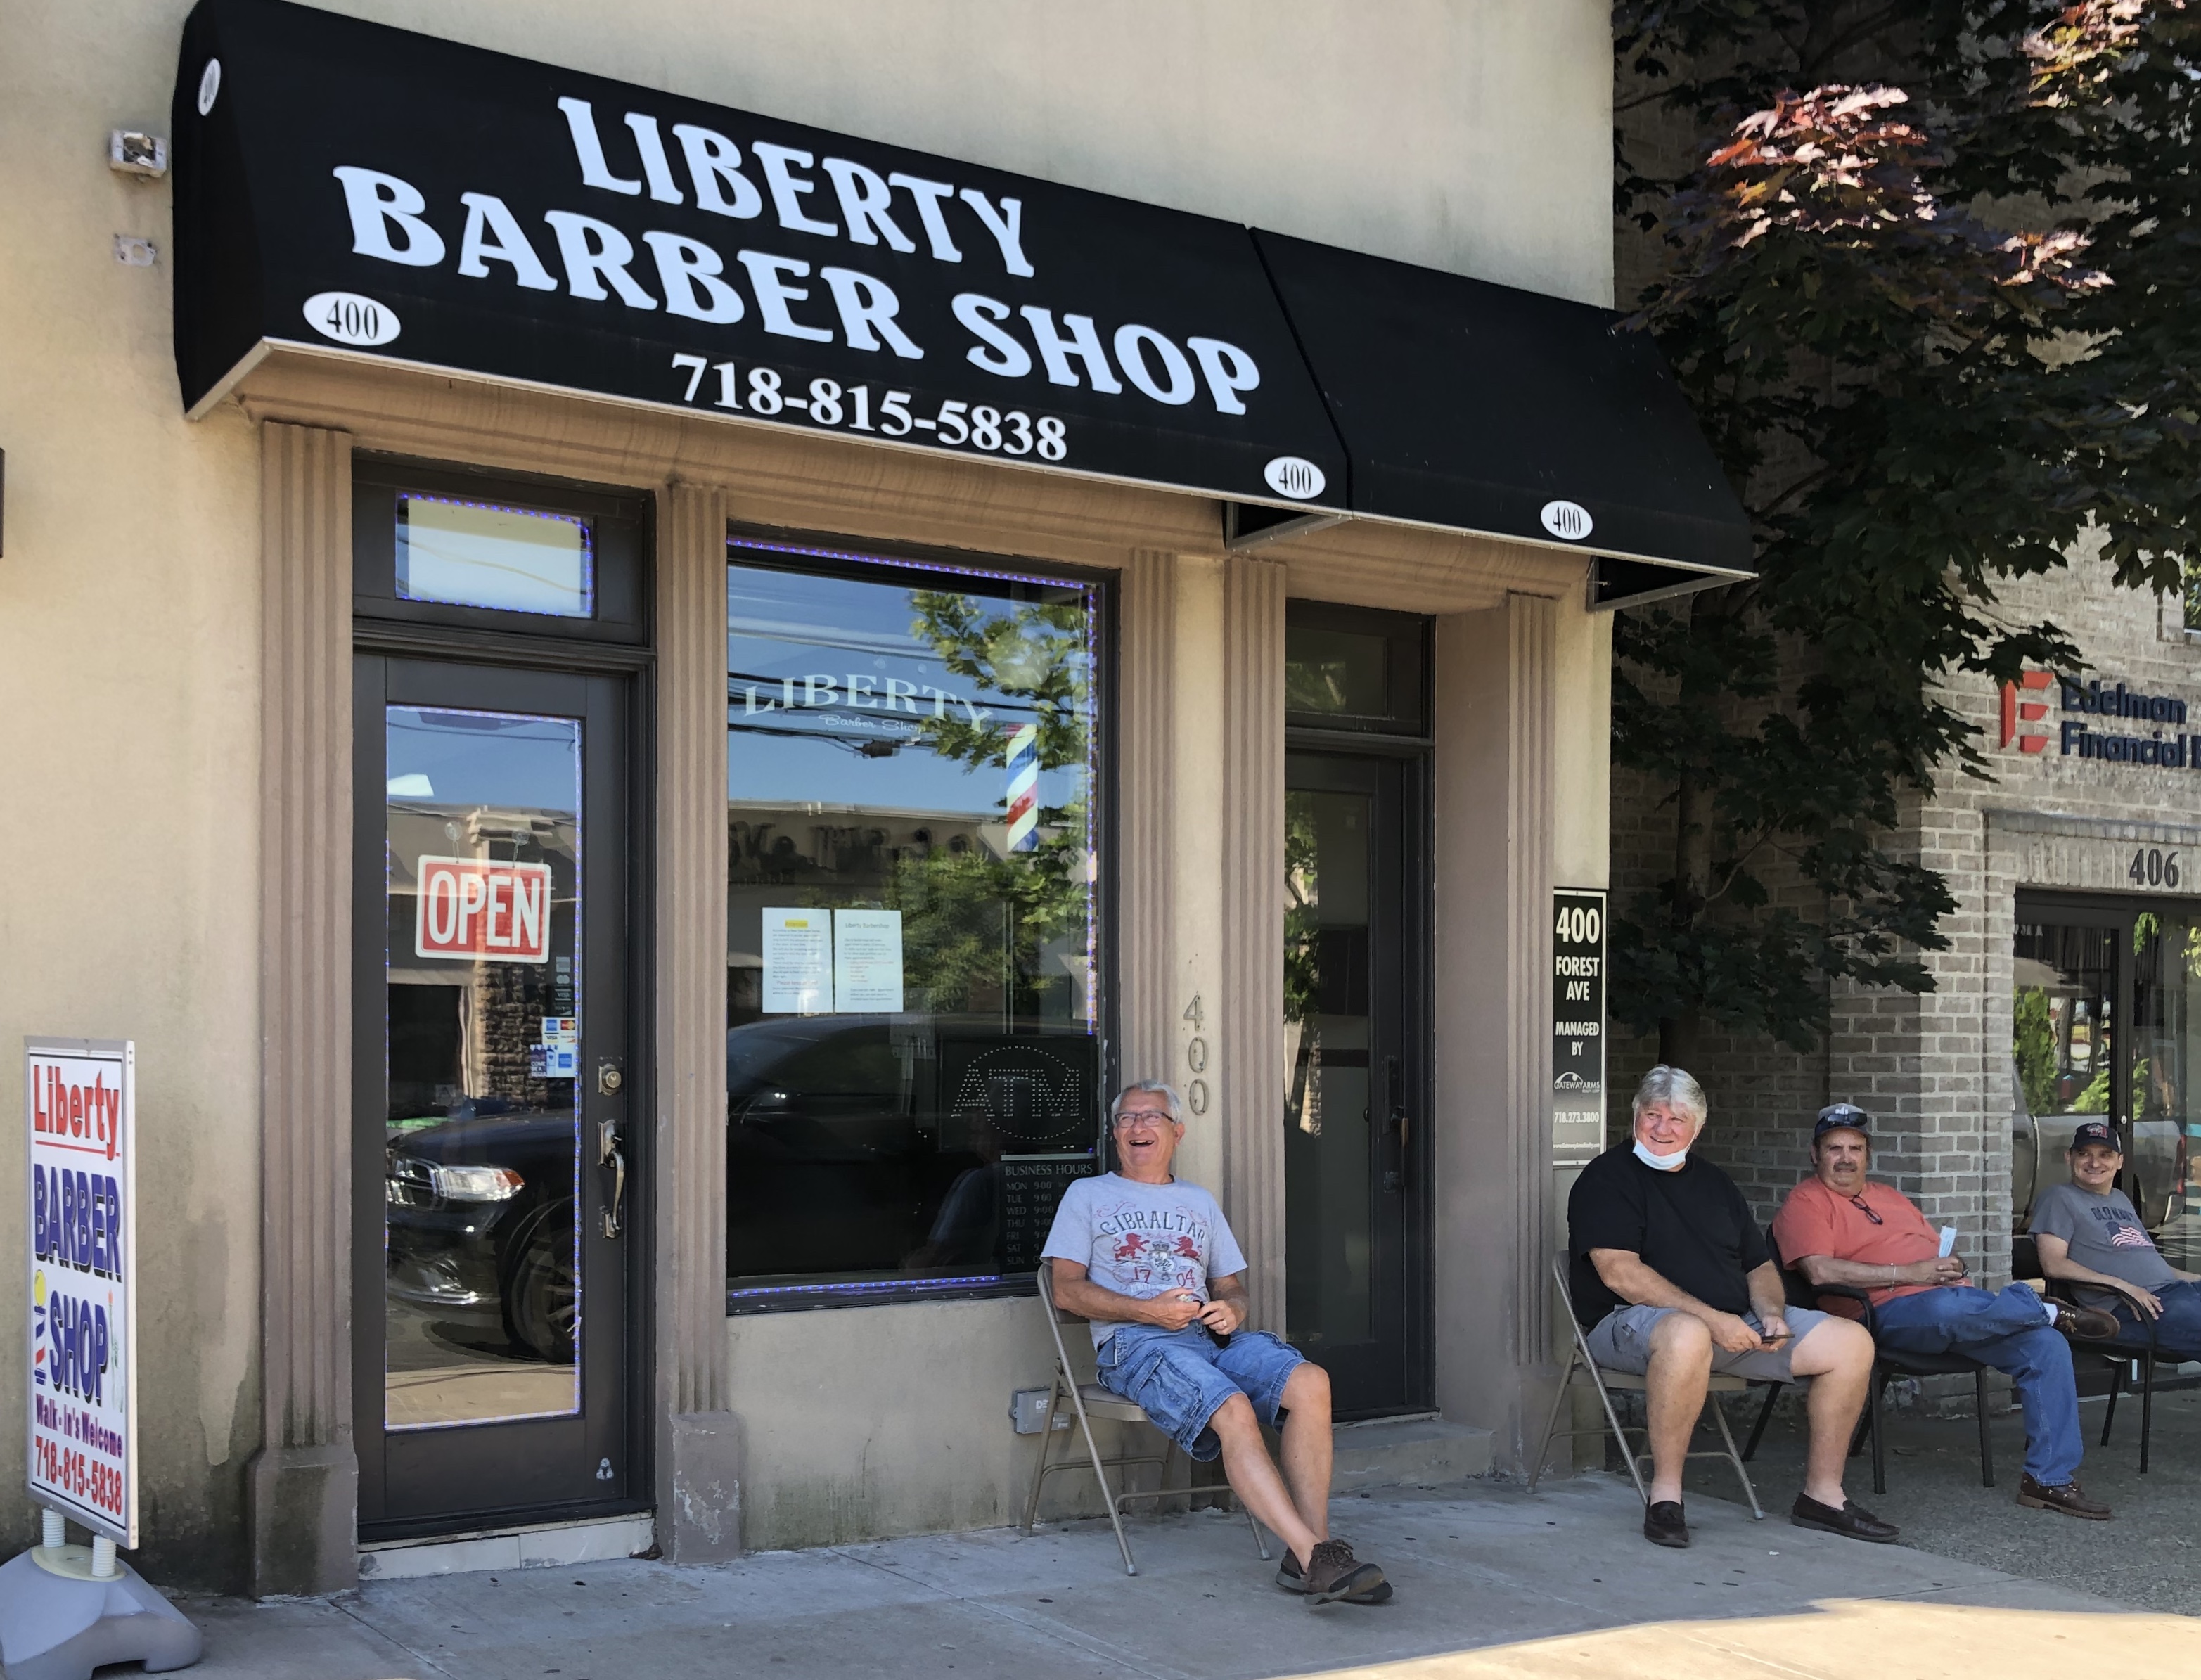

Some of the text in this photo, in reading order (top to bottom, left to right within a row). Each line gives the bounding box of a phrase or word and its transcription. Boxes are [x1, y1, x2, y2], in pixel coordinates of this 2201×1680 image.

[558, 96, 1034, 278] LIBERTY
[333, 165, 1261, 416] BARBER SHOP
[326, 298, 379, 340] 400
[672, 352, 1067, 461] 718-815-5838
[1278, 463, 1311, 494] 400
[1553, 506, 1581, 536] 400
[744, 674, 993, 733] LIBERTY
[2061, 677, 2187, 725] Edelman
[818, 714, 926, 735] Barber Shop
[2061, 720, 2186, 768] Financial
[2129, 848, 2179, 889] 406
[428, 870, 541, 949] OPEN
[1555, 906, 1600, 944] 400
[1555, 955, 1600, 977] FOREST
[1565, 980, 1590, 1001] AVE
[1555, 1021, 1600, 1037] MANAGED
[1183, 994, 1209, 1116] 400
[1572, 1041, 1584, 1056] BY
[951, 1069, 1079, 1117] ATM
[34, 1065, 119, 1161] Liberty
[1554, 1112, 1600, 1123] 718.273.3800
[1005, 1163, 1093, 1176] BUSINESS HOURS
[1006, 1182, 1027, 1191] MON
[1006, 1194, 1022, 1203] TUE
[1006, 1206, 1027, 1215] WED
[34, 1163, 122, 1283] BARBER
[1006, 1219, 1025, 1228] THU
[1006, 1231, 1020, 1240] FRI
[1100, 1210, 1206, 1241] GIBRALTAR
[1006, 1243, 1022, 1252] SAT
[1006, 1256, 1025, 1265] SUN
[49, 1290, 108, 1408] SHOP
[36, 1393, 58, 1431] Walk
[82, 1411, 122, 1460] Welcome
[35, 1435, 122, 1516] 718-815-5838
